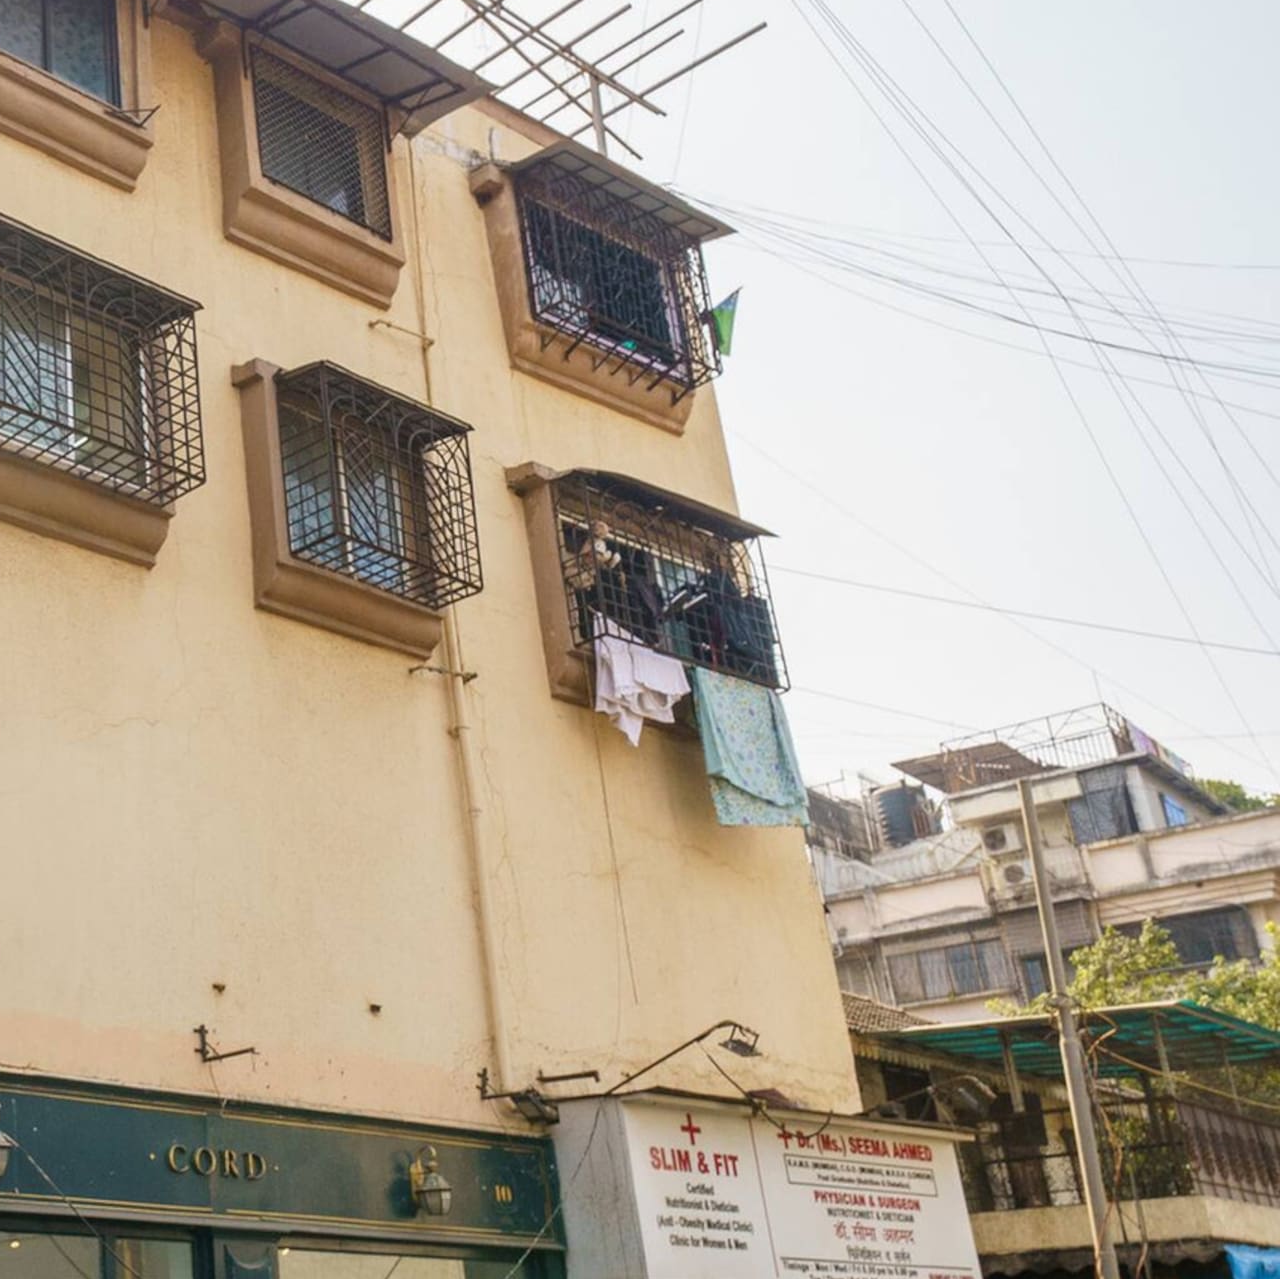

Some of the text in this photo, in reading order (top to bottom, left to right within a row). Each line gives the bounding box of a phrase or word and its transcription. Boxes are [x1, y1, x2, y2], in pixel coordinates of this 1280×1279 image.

[649, 1146, 738, 1177] SLIM & FIT
[797, 1129, 933, 1162] Dr. (Ms.) SEEMA AHMED
[167, 1143, 267, 1181] CORD
[813, 1189, 922, 1212] PHYSICIAN & SURGEON
